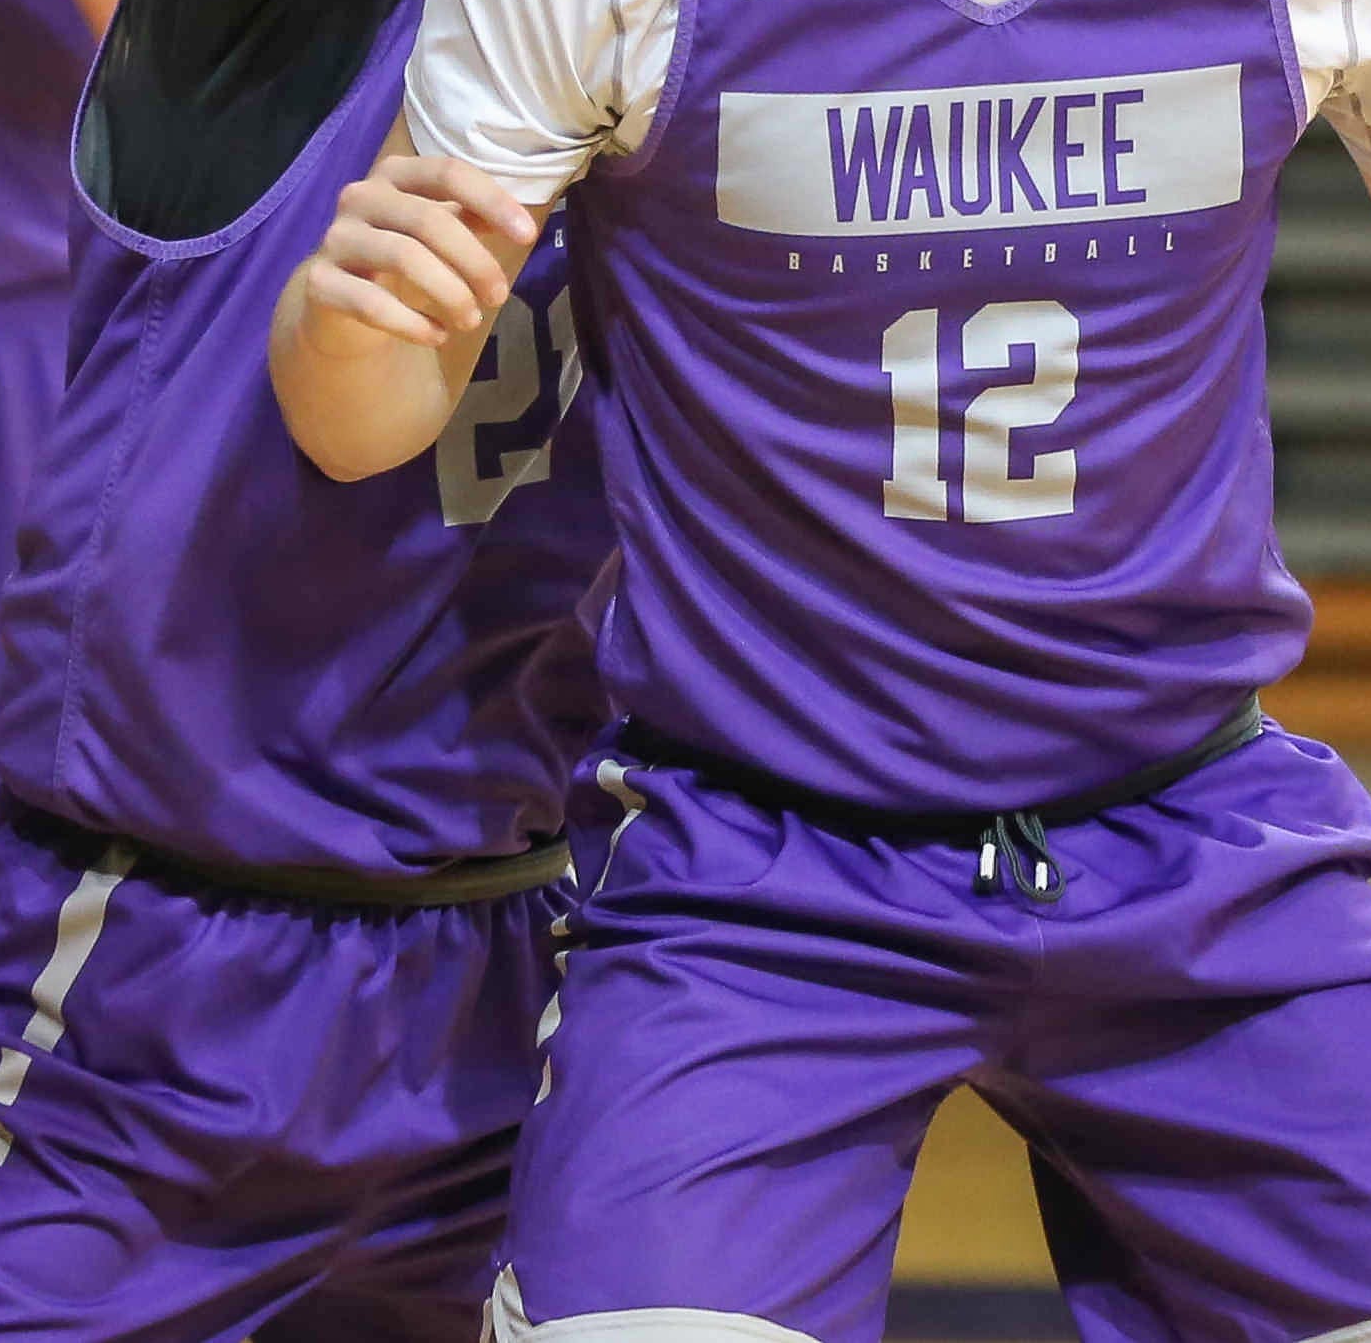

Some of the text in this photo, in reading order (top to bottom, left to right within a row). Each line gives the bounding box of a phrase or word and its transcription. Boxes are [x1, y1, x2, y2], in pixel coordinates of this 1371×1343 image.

[827, 89, 1147, 223] WAUKEE
[789, 231, 1175, 274] BASKETBALL
[881, 299, 1079, 524] 12
